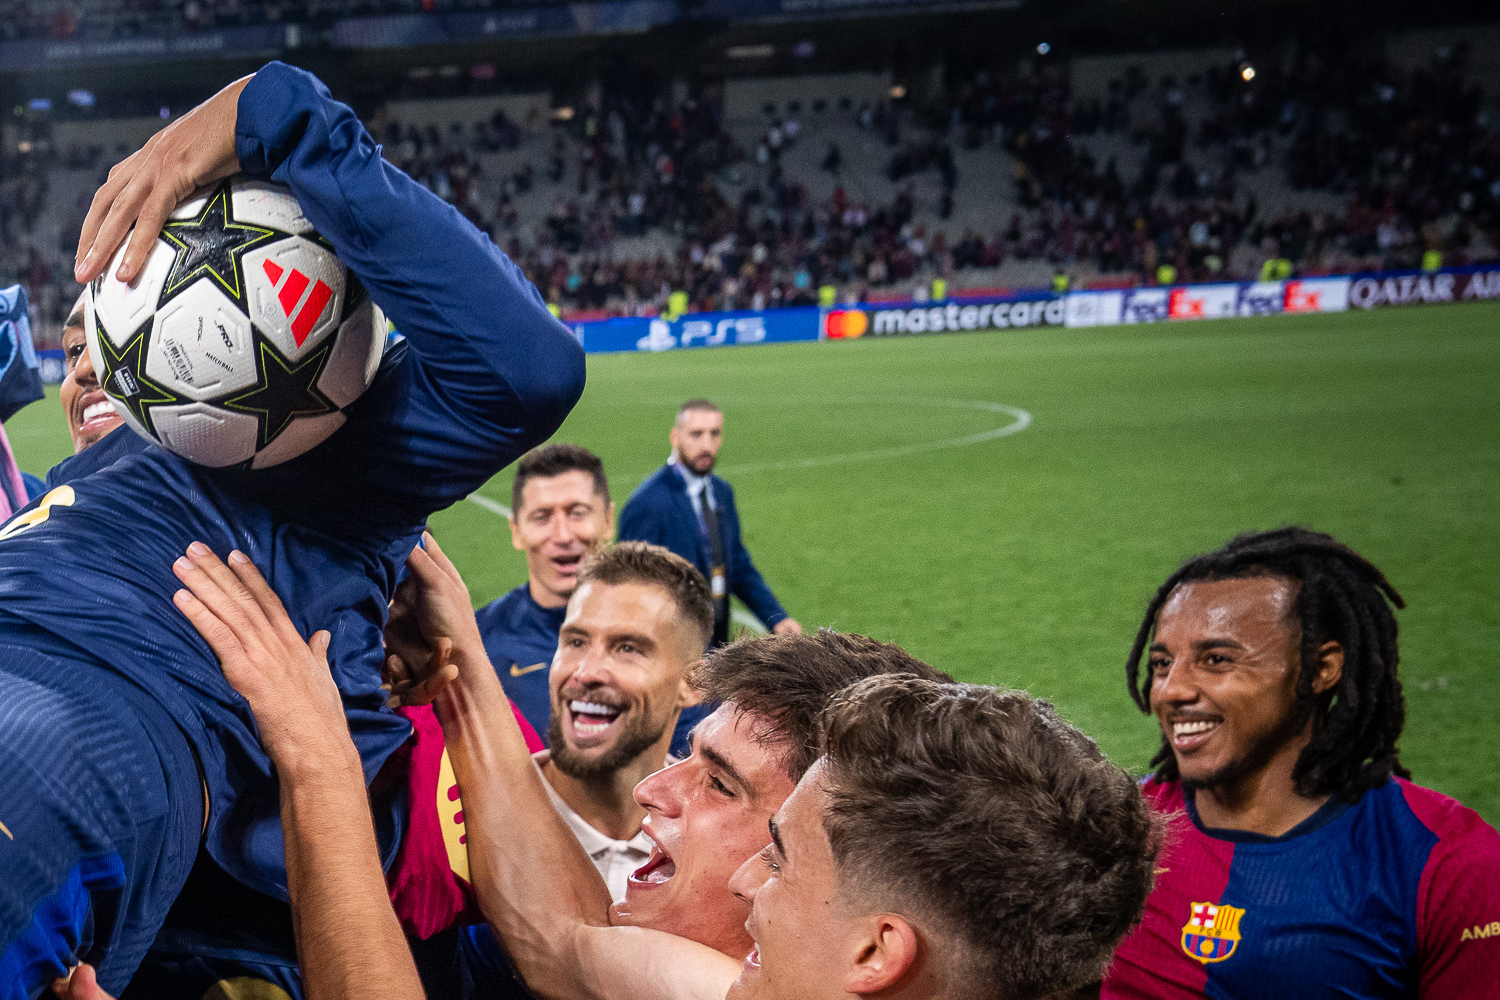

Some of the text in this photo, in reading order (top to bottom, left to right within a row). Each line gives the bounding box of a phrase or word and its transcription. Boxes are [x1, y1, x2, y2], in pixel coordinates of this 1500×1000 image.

[1351, 272, 1455, 309] QATAR
[681, 316, 766, 347] PS5
[874, 297, 1065, 334] mastercard
